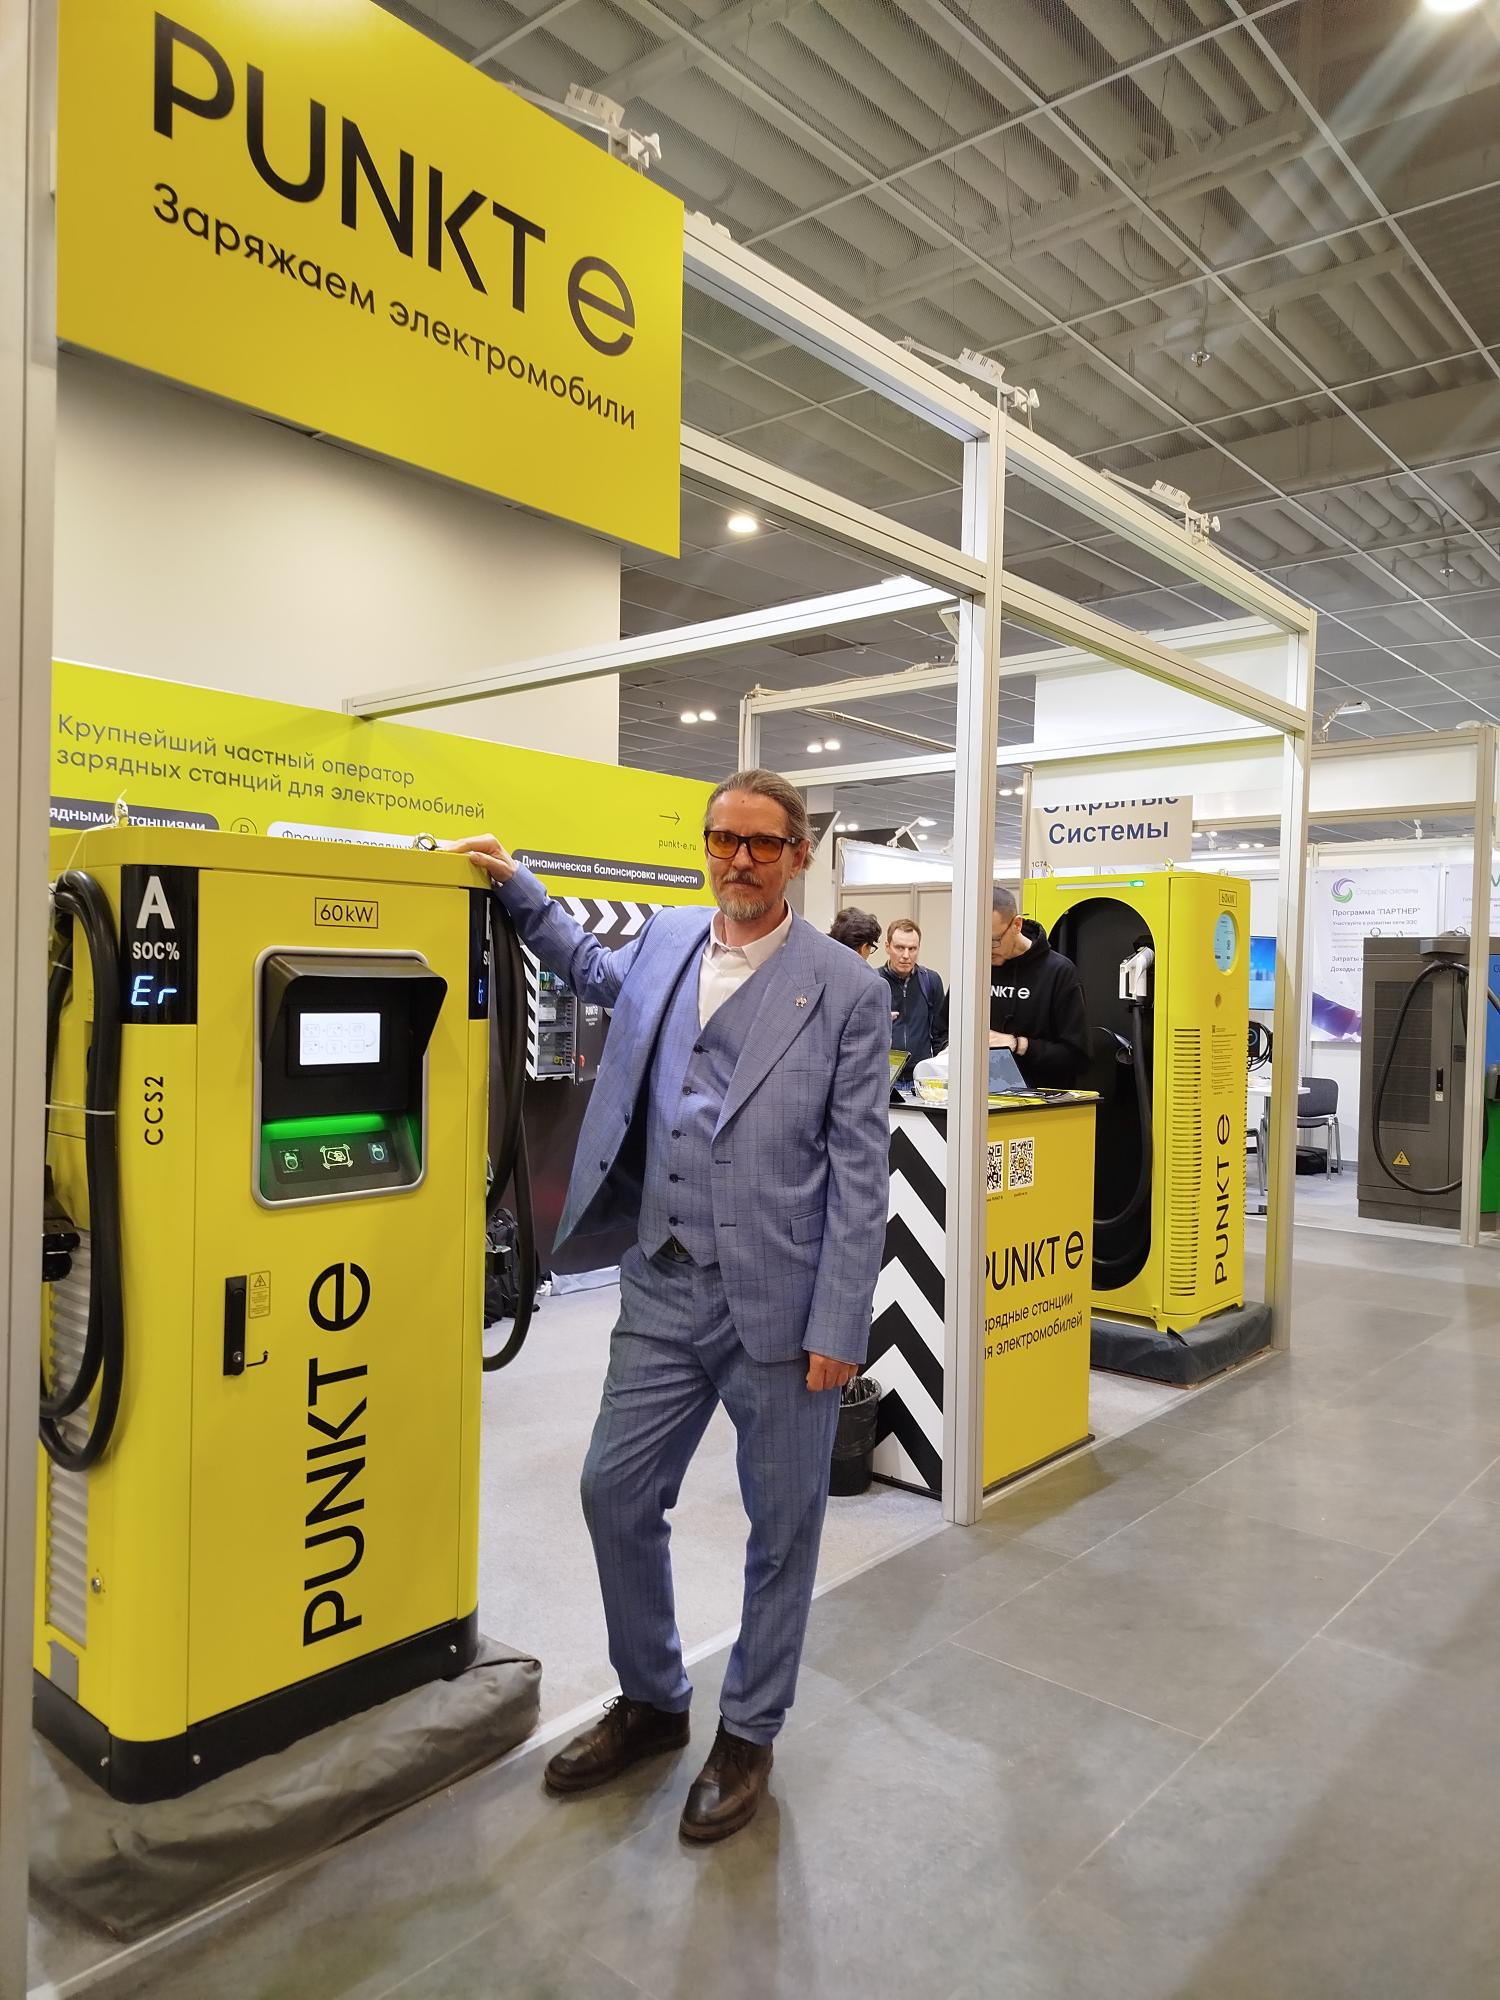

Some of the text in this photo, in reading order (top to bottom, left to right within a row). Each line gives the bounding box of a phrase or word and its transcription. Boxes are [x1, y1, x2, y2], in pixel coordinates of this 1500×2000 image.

[154, 11, 636, 357] PUNKT e
[153, 182, 636, 431] Заряжаем электромобили
[58, 714, 415, 788] Крупнейший частный оператор
[56, 749, 485, 820] зарядных станций для электромобилей
[128, 816, 206, 831] танциями
[658, 839, 697, 851] punkt-e.ru
[1049, 821, 1169, 845] Системы
[522, 855, 698, 885] Динамическая балансировка мощности
[136, 875, 175, 929] A
[1332, 909, 1376, 917] Программа
[132, 941, 180, 961] SOC%
[130, 975, 177, 1006] Er
[144, 1076, 164, 1146] CCS2
[1215, 1114, 1230, 1285] PUNKT e
[1065, 1230, 1084, 1270] e
[1031, 1292, 1073, 1316] станции
[996, 1310, 1083, 1356] электромобилей
[303, 1262, 371, 1647] PUNKT e
